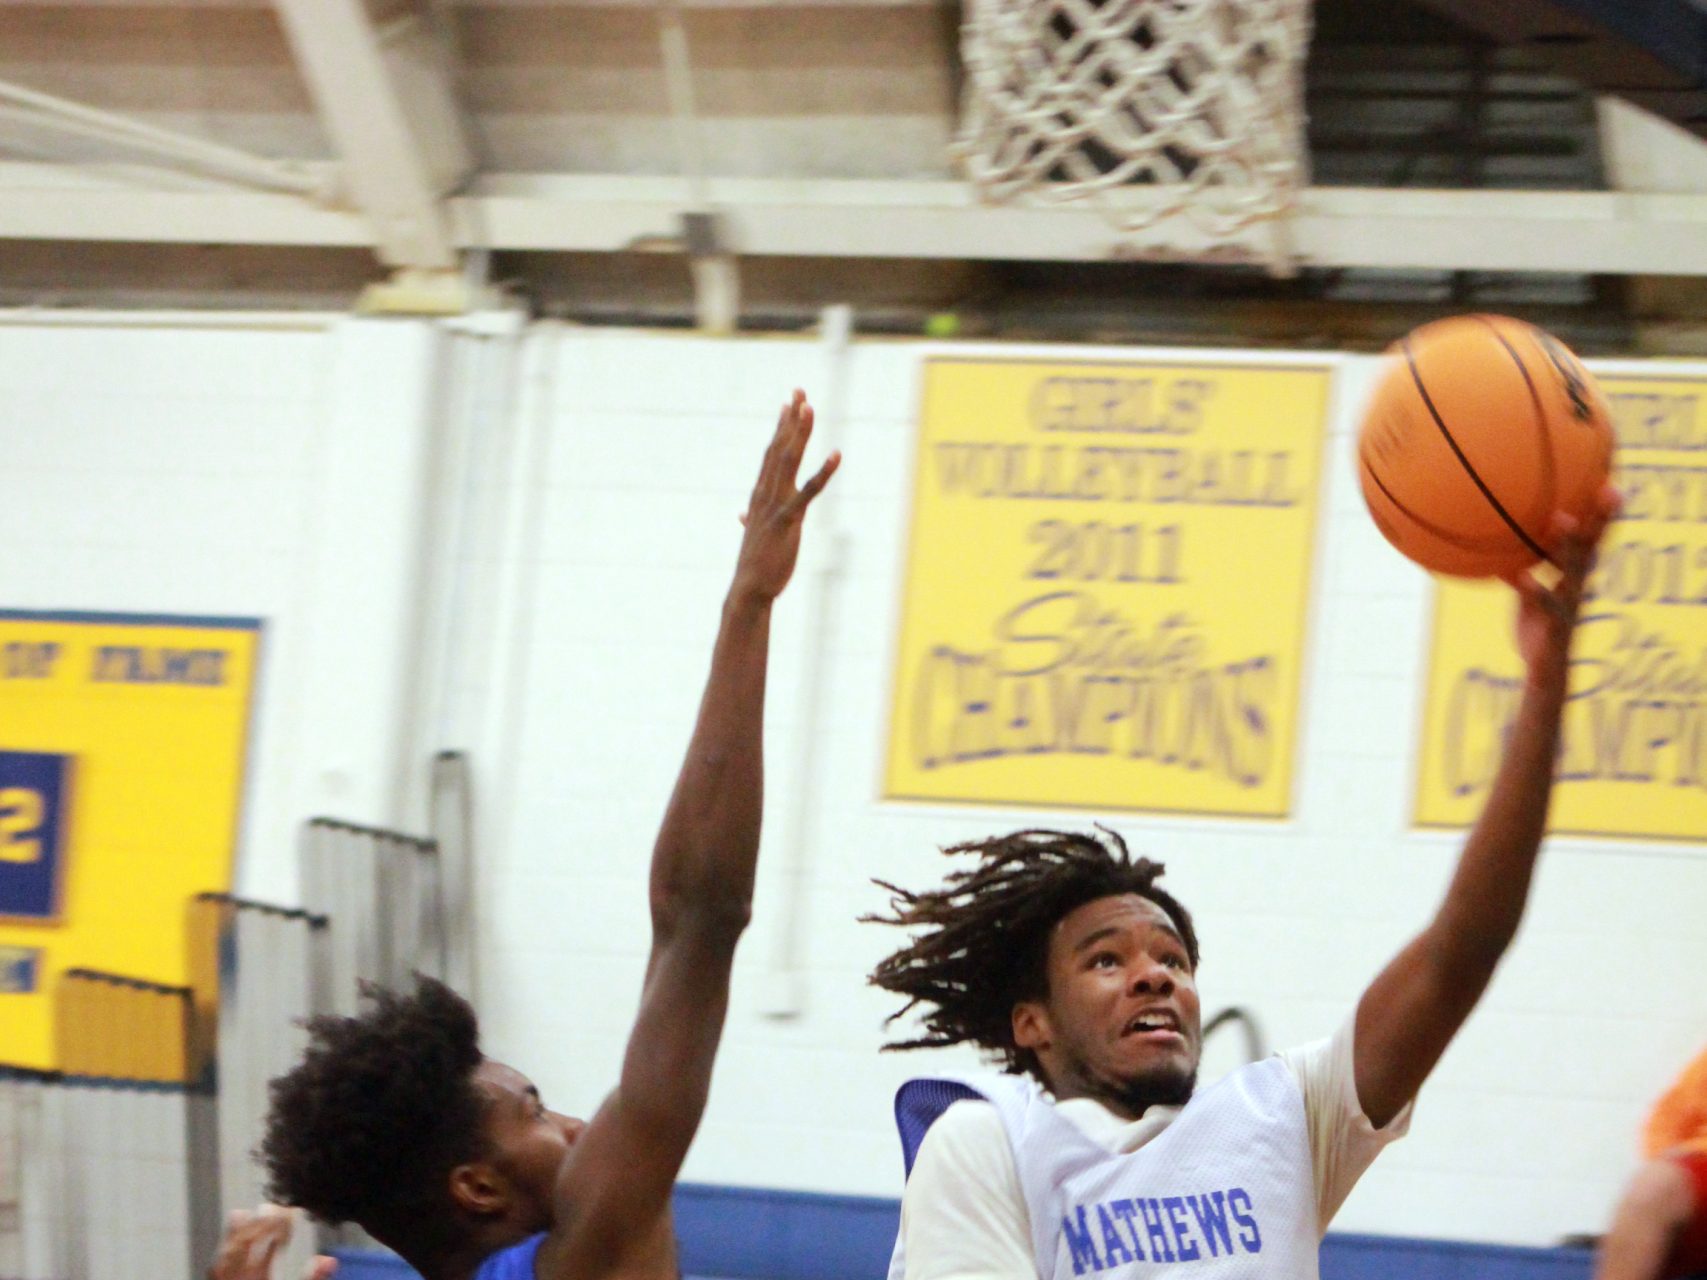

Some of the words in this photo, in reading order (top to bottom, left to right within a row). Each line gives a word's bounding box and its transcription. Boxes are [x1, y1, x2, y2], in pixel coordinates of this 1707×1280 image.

[1028, 377, 1217, 434] GIRLS
[933, 441, 1298, 508] VOLLEYBALL
[1024, 518, 1185, 585] 2011
[911, 645, 1274, 788] CHAMPIONS
[1062, 1187, 1262, 1276] MATHEWS
